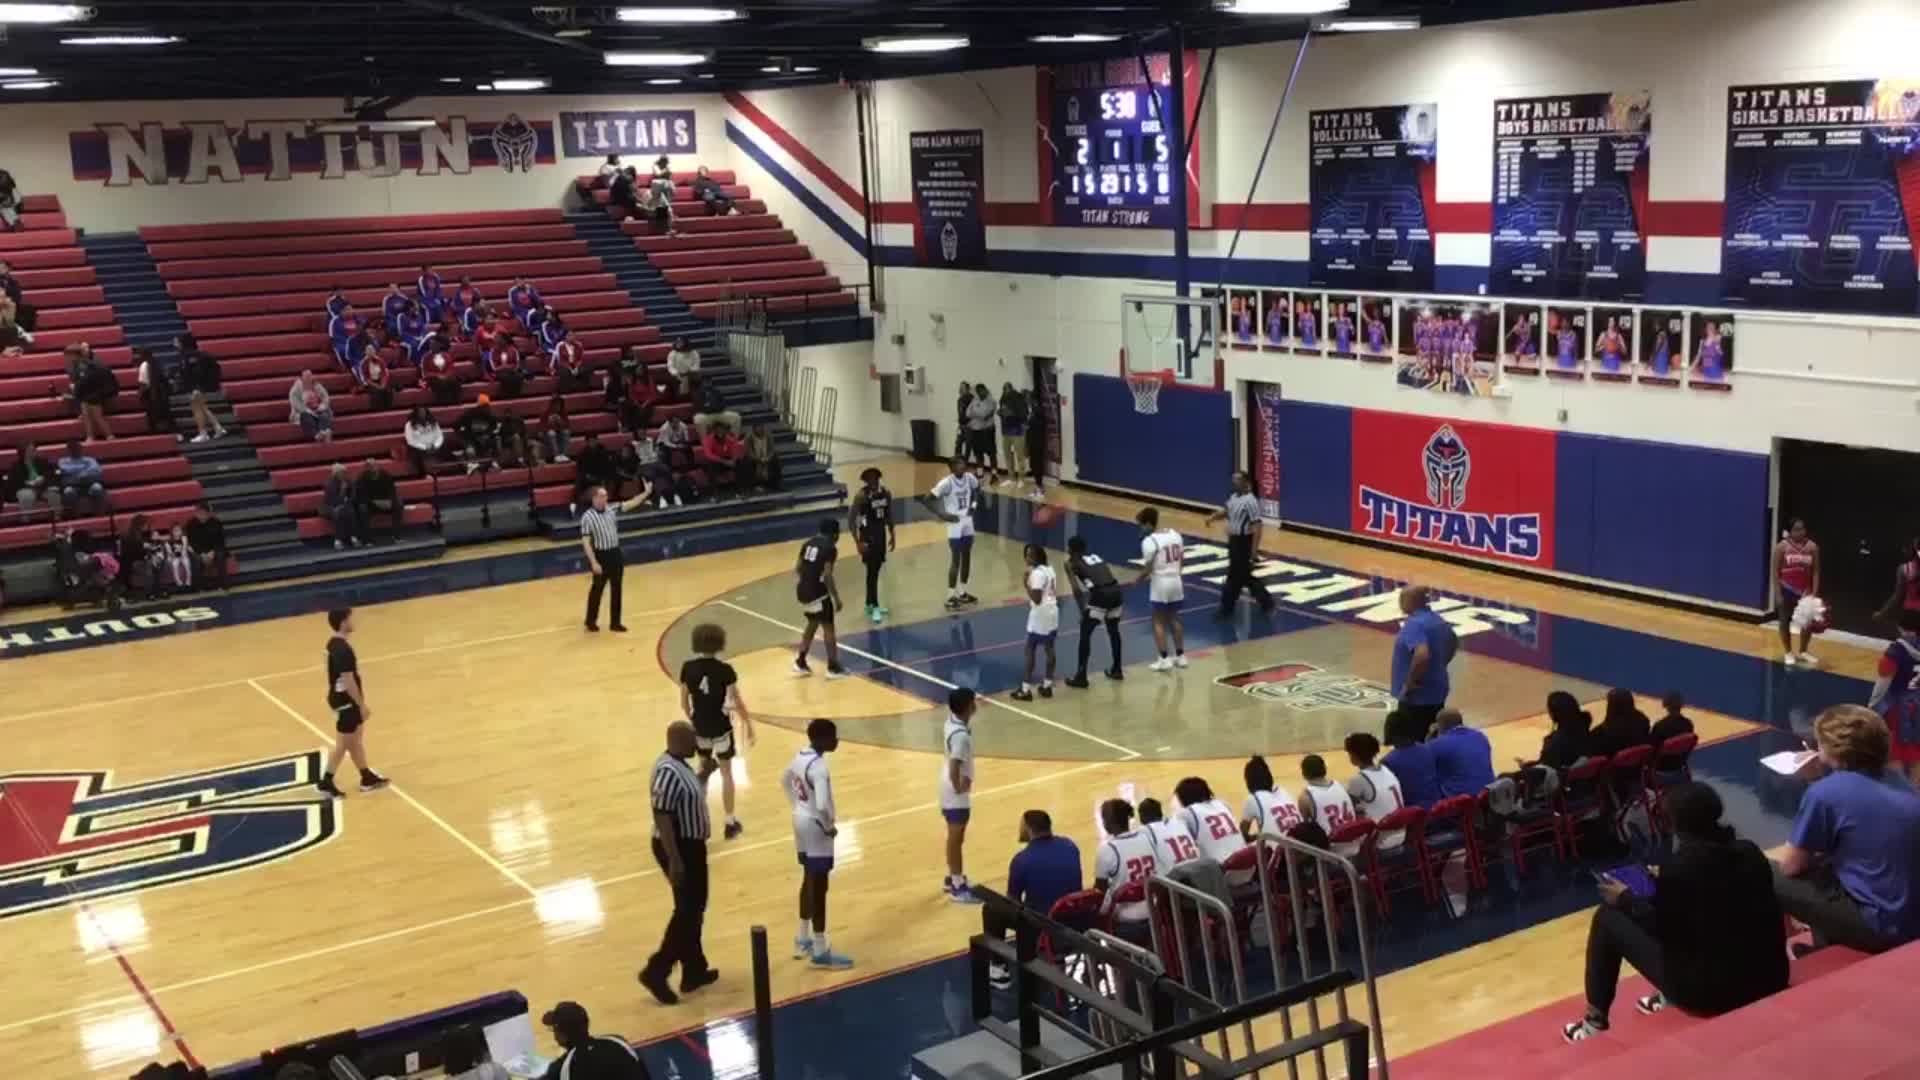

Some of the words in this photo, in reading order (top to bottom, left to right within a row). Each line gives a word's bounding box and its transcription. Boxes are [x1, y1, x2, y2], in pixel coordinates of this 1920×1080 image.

[1733, 87, 1826, 109] TITANS
[1313, 111, 1373, 129] TITANS
[1497, 101, 1571, 120] TITANS
[1732, 109, 1778, 125] GIRLS
[572, 117, 690, 150] TITANS
[1313, 127, 1382, 142] VOLLEYBALL
[1497, 119, 1529, 136] BOYS
[1077, 138, 1089, 165] 2
[1113, 141, 1120, 159] 1
[1155, 134, 1168, 162] 5
[1072, 175, 1079, 193] 1
[1081, 209, 1109, 223] TITAN
[1111, 209, 1150, 225] STRONG
[1359, 484, 1541, 560] TITANS
[699, 675, 709, 695] 4
[1204, 813, 1238, 841] 21
[1165, 834, 1197, 864] 12
